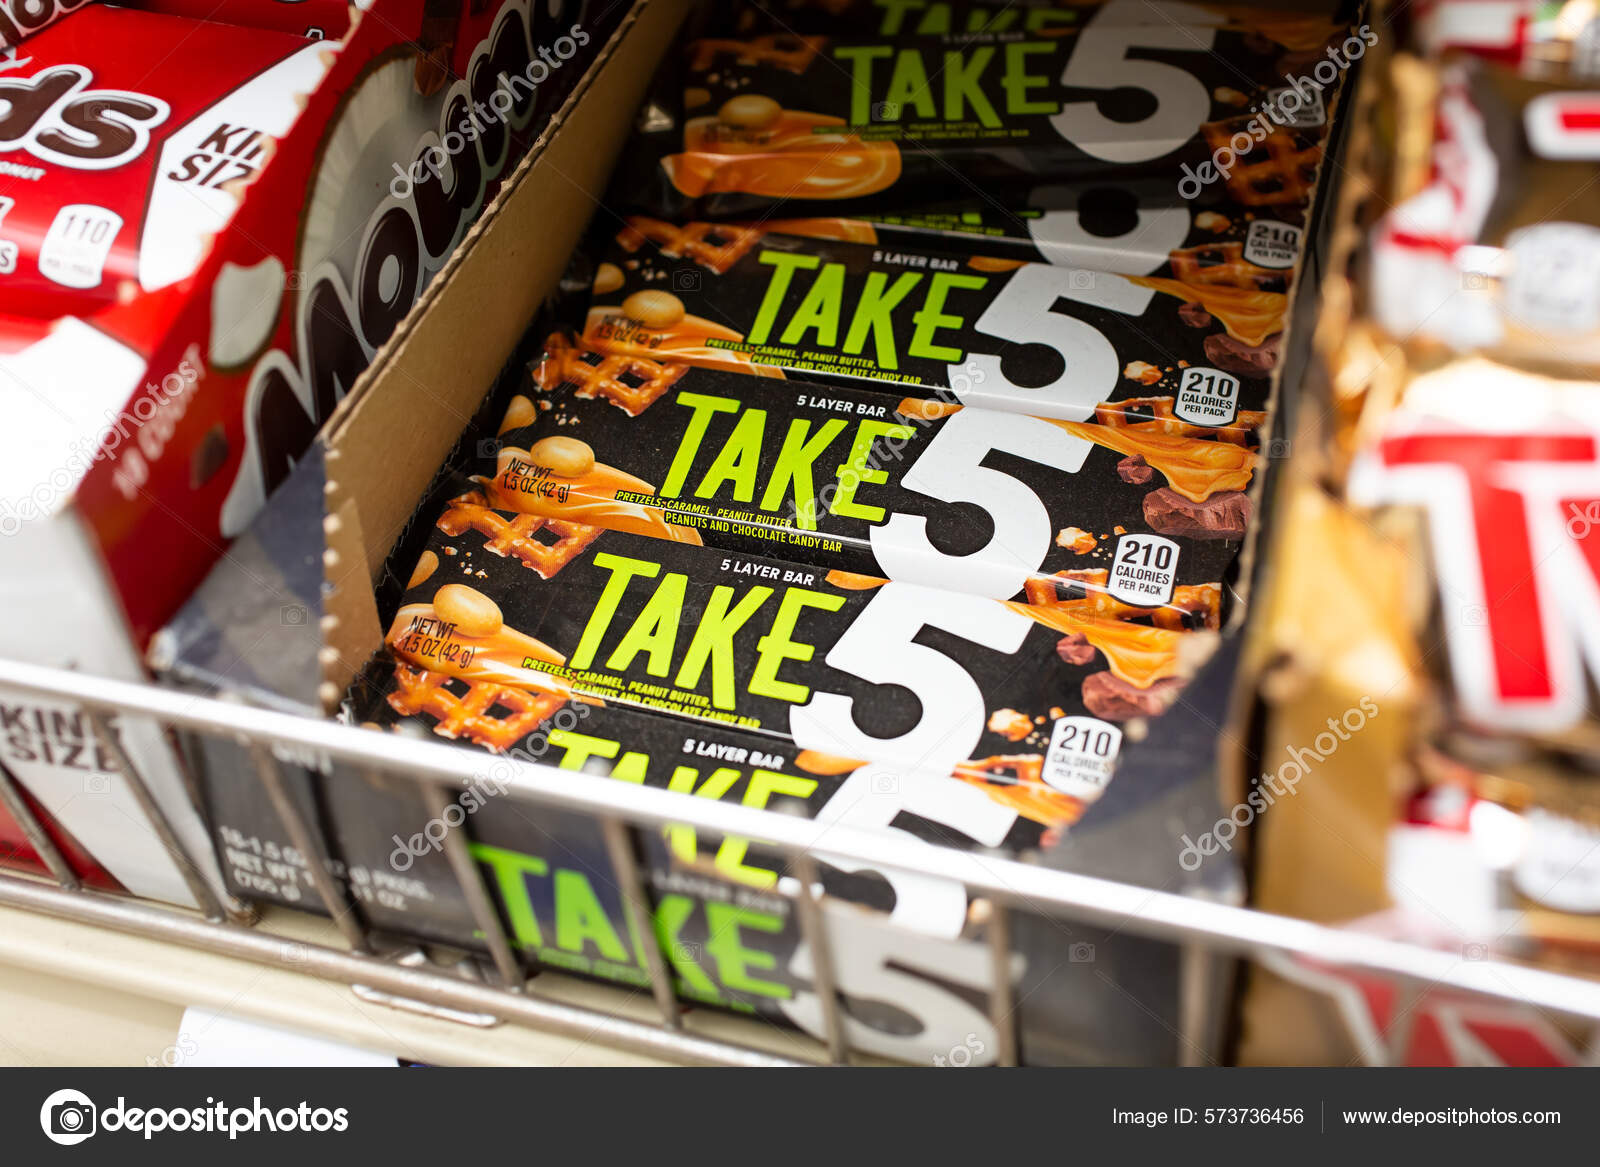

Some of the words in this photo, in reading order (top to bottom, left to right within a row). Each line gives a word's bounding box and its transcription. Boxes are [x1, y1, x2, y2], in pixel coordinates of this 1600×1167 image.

[834, 42, 1059, 129] TAKE
[1049, 26, 1217, 164] 5
[1254, 224, 1298, 247] 210
[872, 250, 883, 262] 5
[884, 252, 928, 268] LAYER
[929, 257, 960, 271] BAR
[748, 250, 989, 370] TAKE
[947, 262, 1158, 421] 5
[794, 360, 814, 371] AND
[815, 363, 868, 378] CHOCOLATE
[869, 370, 901, 383] CANDY
[902, 375, 922, 386] BAR
[801, 351, 839, 364] PEANUT
[839, 356, 877, 369] BUTTER,
[1186, 372, 1234, 398] 210
[796, 394, 807, 406] 5
[809, 396, 854, 413] LAYER
[856, 403, 887, 418] BAR
[1181, 392, 1233, 410] CALORIES
[1184, 404, 1202, 414] PER
[1203, 406, 1226, 417] PACK
[507, 457, 534, 476] NET
[533, 465, 554, 480] WT
[503, 472, 517, 491] 1.5
[520, 477, 538, 494] OZ
[536, 479, 556, 498] (42
[557, 483, 571, 504] g)
[659, 391, 918, 532] TAKE
[870, 405, 1096, 600] 5
[666, 500, 714, 517] CARAMEL,
[716, 508, 755, 523] PEANUT
[755, 514, 796, 530] BUTTER,
[665, 512, 708, 529] PEANUTS
[709, 521, 730, 533] AND
[732, 525, 787, 544] CHOCOLATE
[788, 533, 821, 550] CANDY
[822, 540, 843, 553] BAR
[1121, 540, 1173, 570] 210
[720, 558, 731, 571] 5
[733, 560, 780, 580] LAYER
[782, 570, 815, 586] BAR
[1115, 564, 1170, 585] CALORIES
[1118, 578, 1136, 591] PER
[1138, 582, 1163, 596] PACK
[408, 615, 438, 636] NET
[436, 620, 458, 640] WT
[402, 635, 422, 654] 1.5
[421, 638, 441, 658] OZ
[438, 640, 461, 663] (42
[459, 646, 476, 669] g)
[571, 552, 847, 711] TAKE
[790, 581, 1036, 776] 5
[576, 669, 626, 690] CARAMEL,
[627, 680, 670, 698] PEANUT
[669, 687, 712, 709] BUTTER,
[682, 738, 696, 754] 5
[696, 740, 749, 764] LAYER
[749, 750, 785, 771] BAR
[1059, 724, 1112, 757] 210
